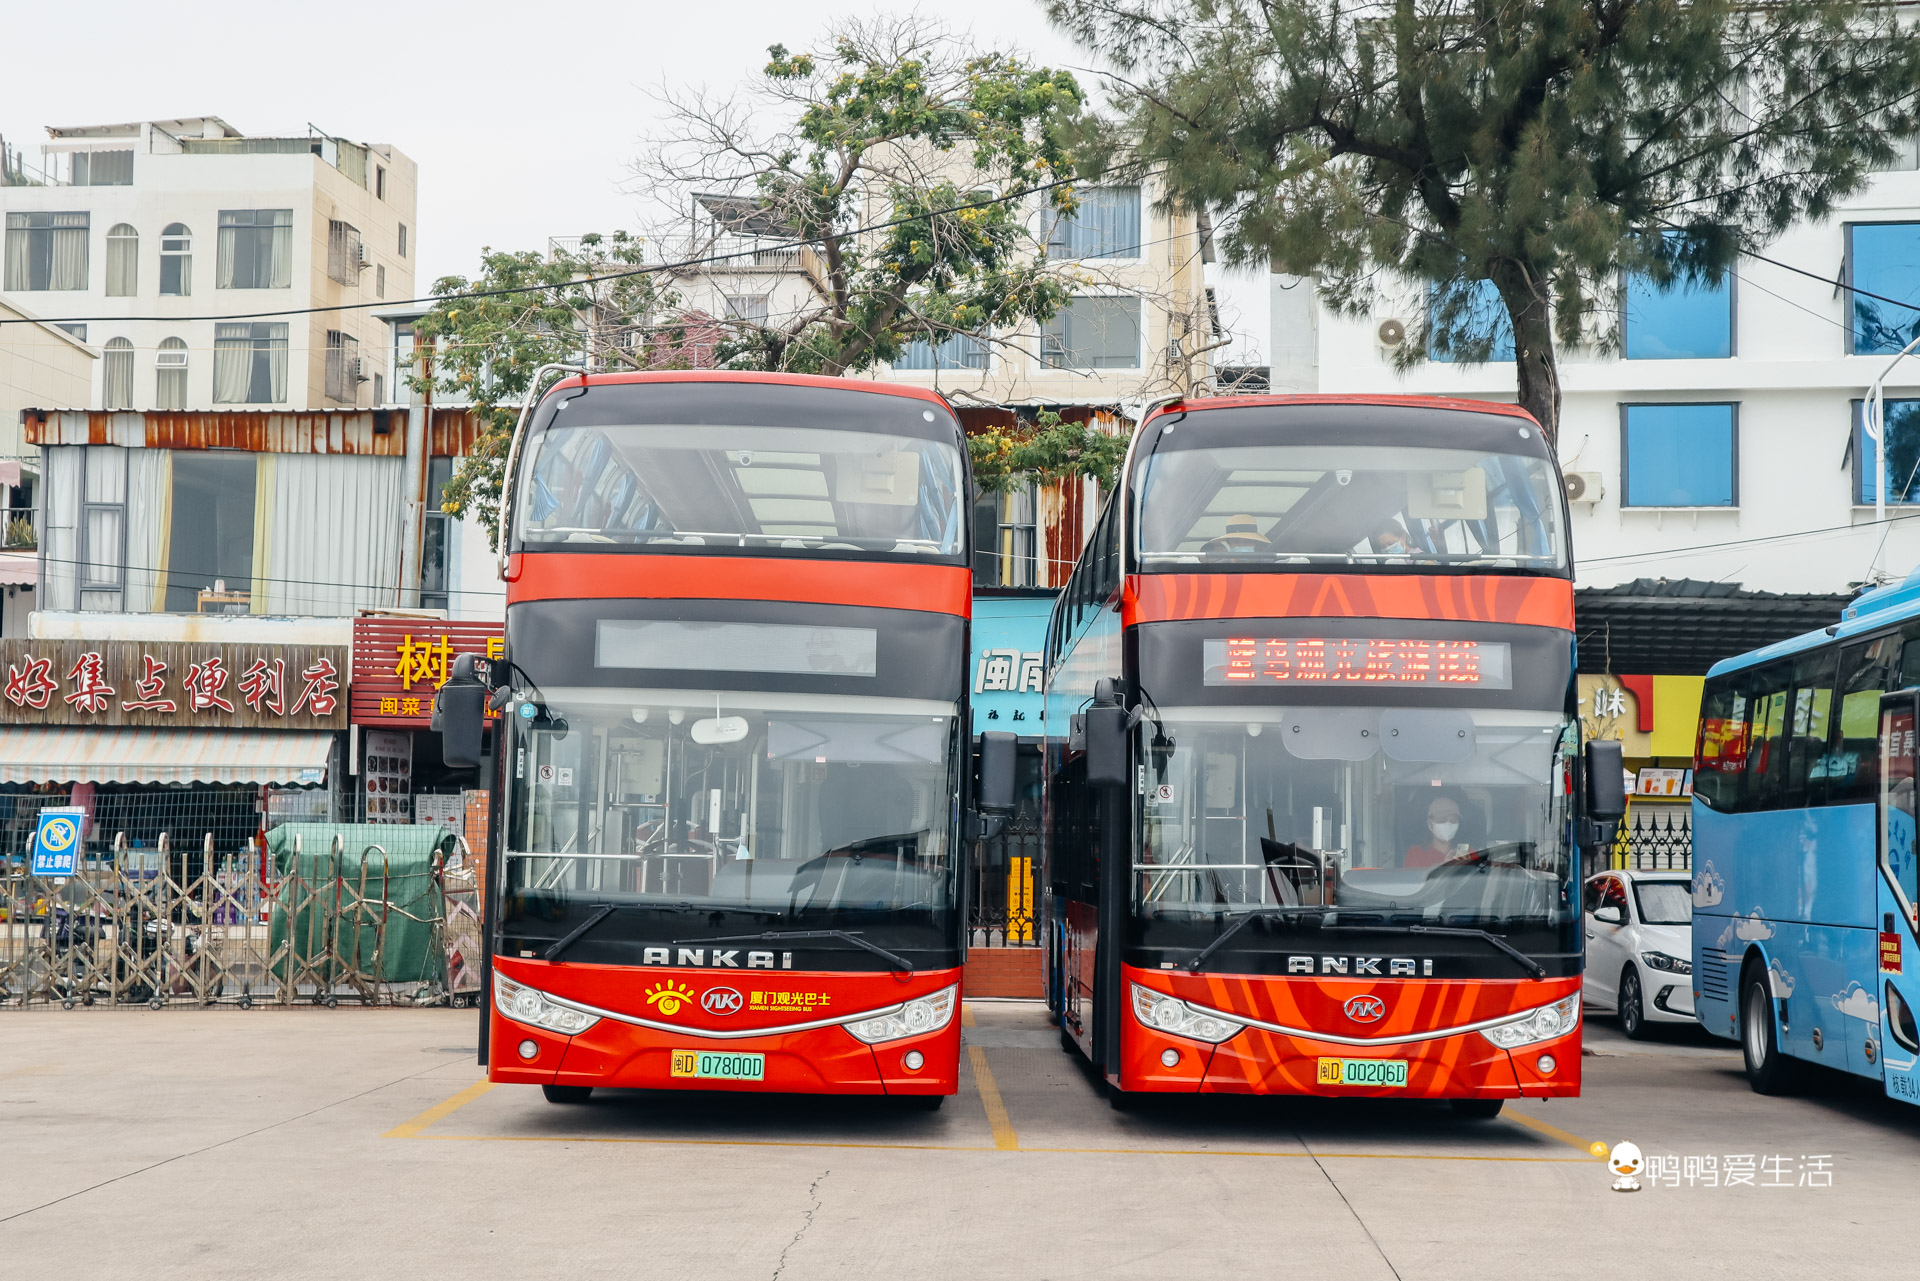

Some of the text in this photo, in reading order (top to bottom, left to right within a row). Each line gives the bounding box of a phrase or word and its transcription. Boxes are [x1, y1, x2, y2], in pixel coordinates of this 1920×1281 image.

[5, 652, 339, 717] 好集点便利店
[36, 854, 72, 869] 禁止攀爬
[643, 947, 793, 969] ANKAI
[1288, 956, 1433, 976] ANKAI
[749, 991, 831, 1006] 厦门观光巴士
